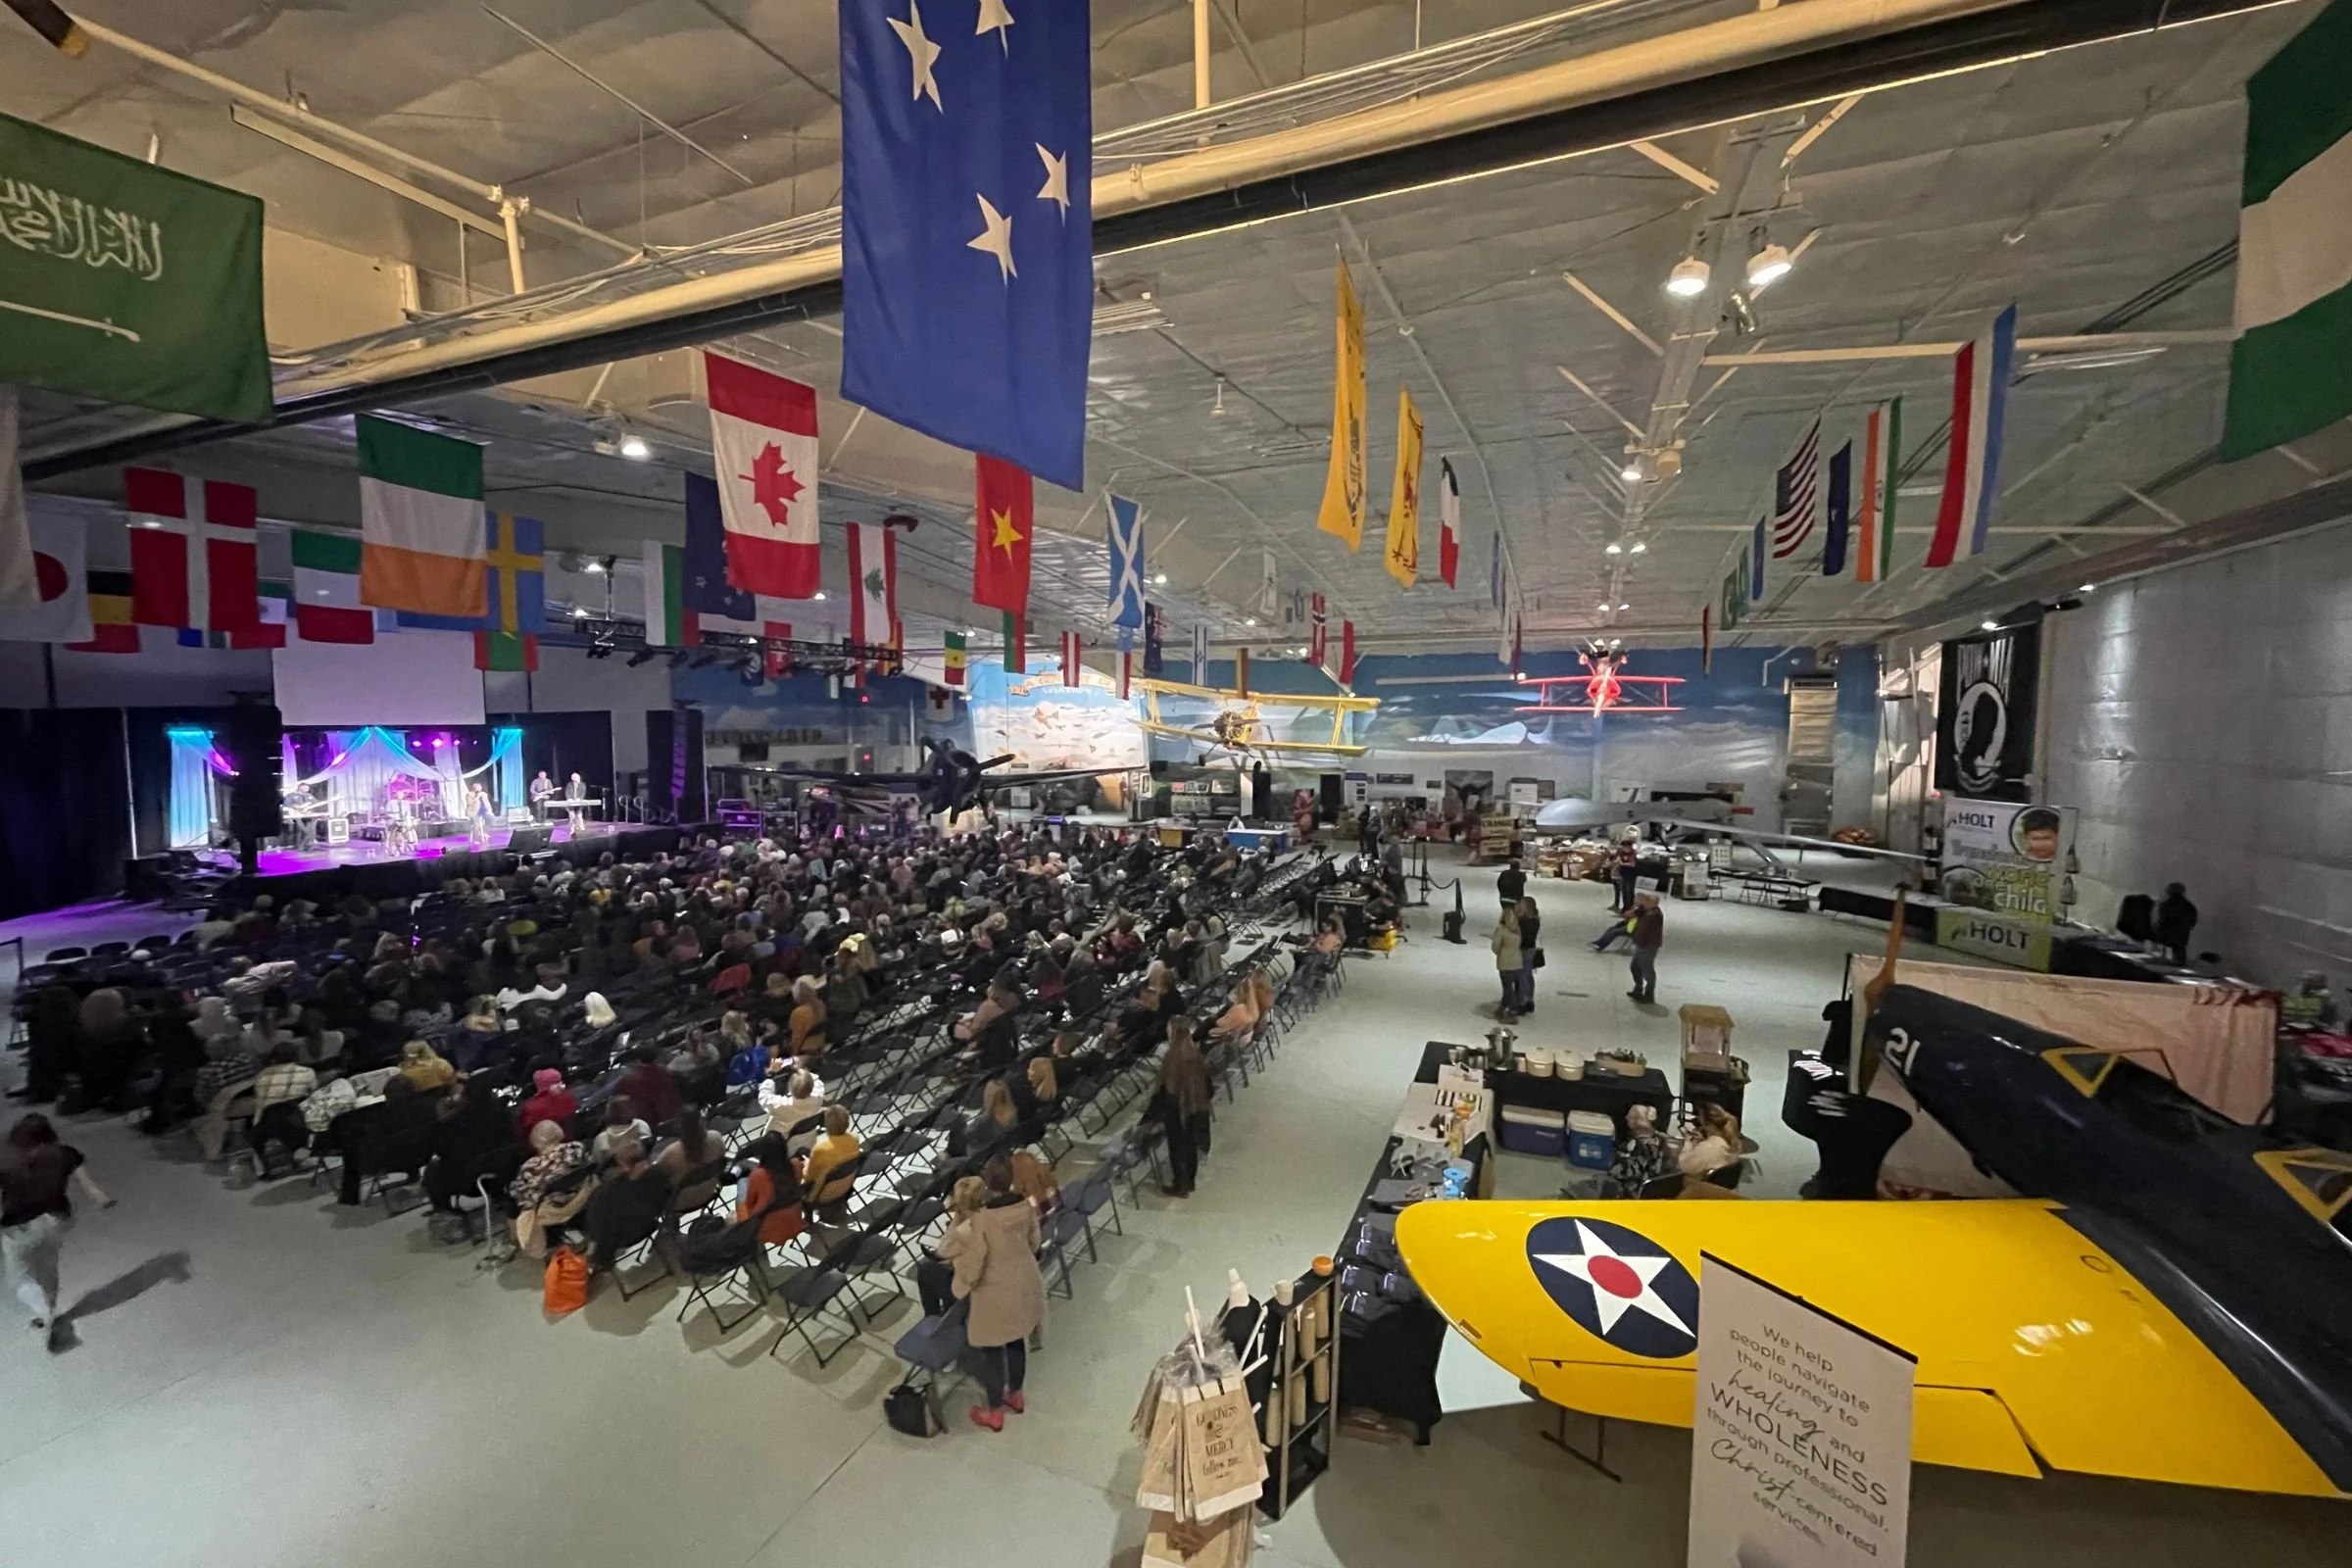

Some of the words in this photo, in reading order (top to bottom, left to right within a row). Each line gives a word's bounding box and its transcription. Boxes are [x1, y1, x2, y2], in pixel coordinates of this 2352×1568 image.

[1958, 811, 1995, 829] HOLT
[1970, 920, 2031, 950] HOLT
[1885, 1027, 1921, 1077] 21
[1730, 1329, 1786, 1366] people
[1792, 1362, 1871, 1413] navigate
[1763, 1324, 1789, 1348] We
[1795, 1342, 1834, 1373] help
[1738, 1349, 1763, 1373] the
[1838, 1407, 1859, 1428] to
[1706, 1406, 1769, 1455] through
[1728, 1368, 1825, 1443] healing
[1829, 1436, 1866, 1464] and
[1710, 1382, 1887, 1506] WHOLENESS
